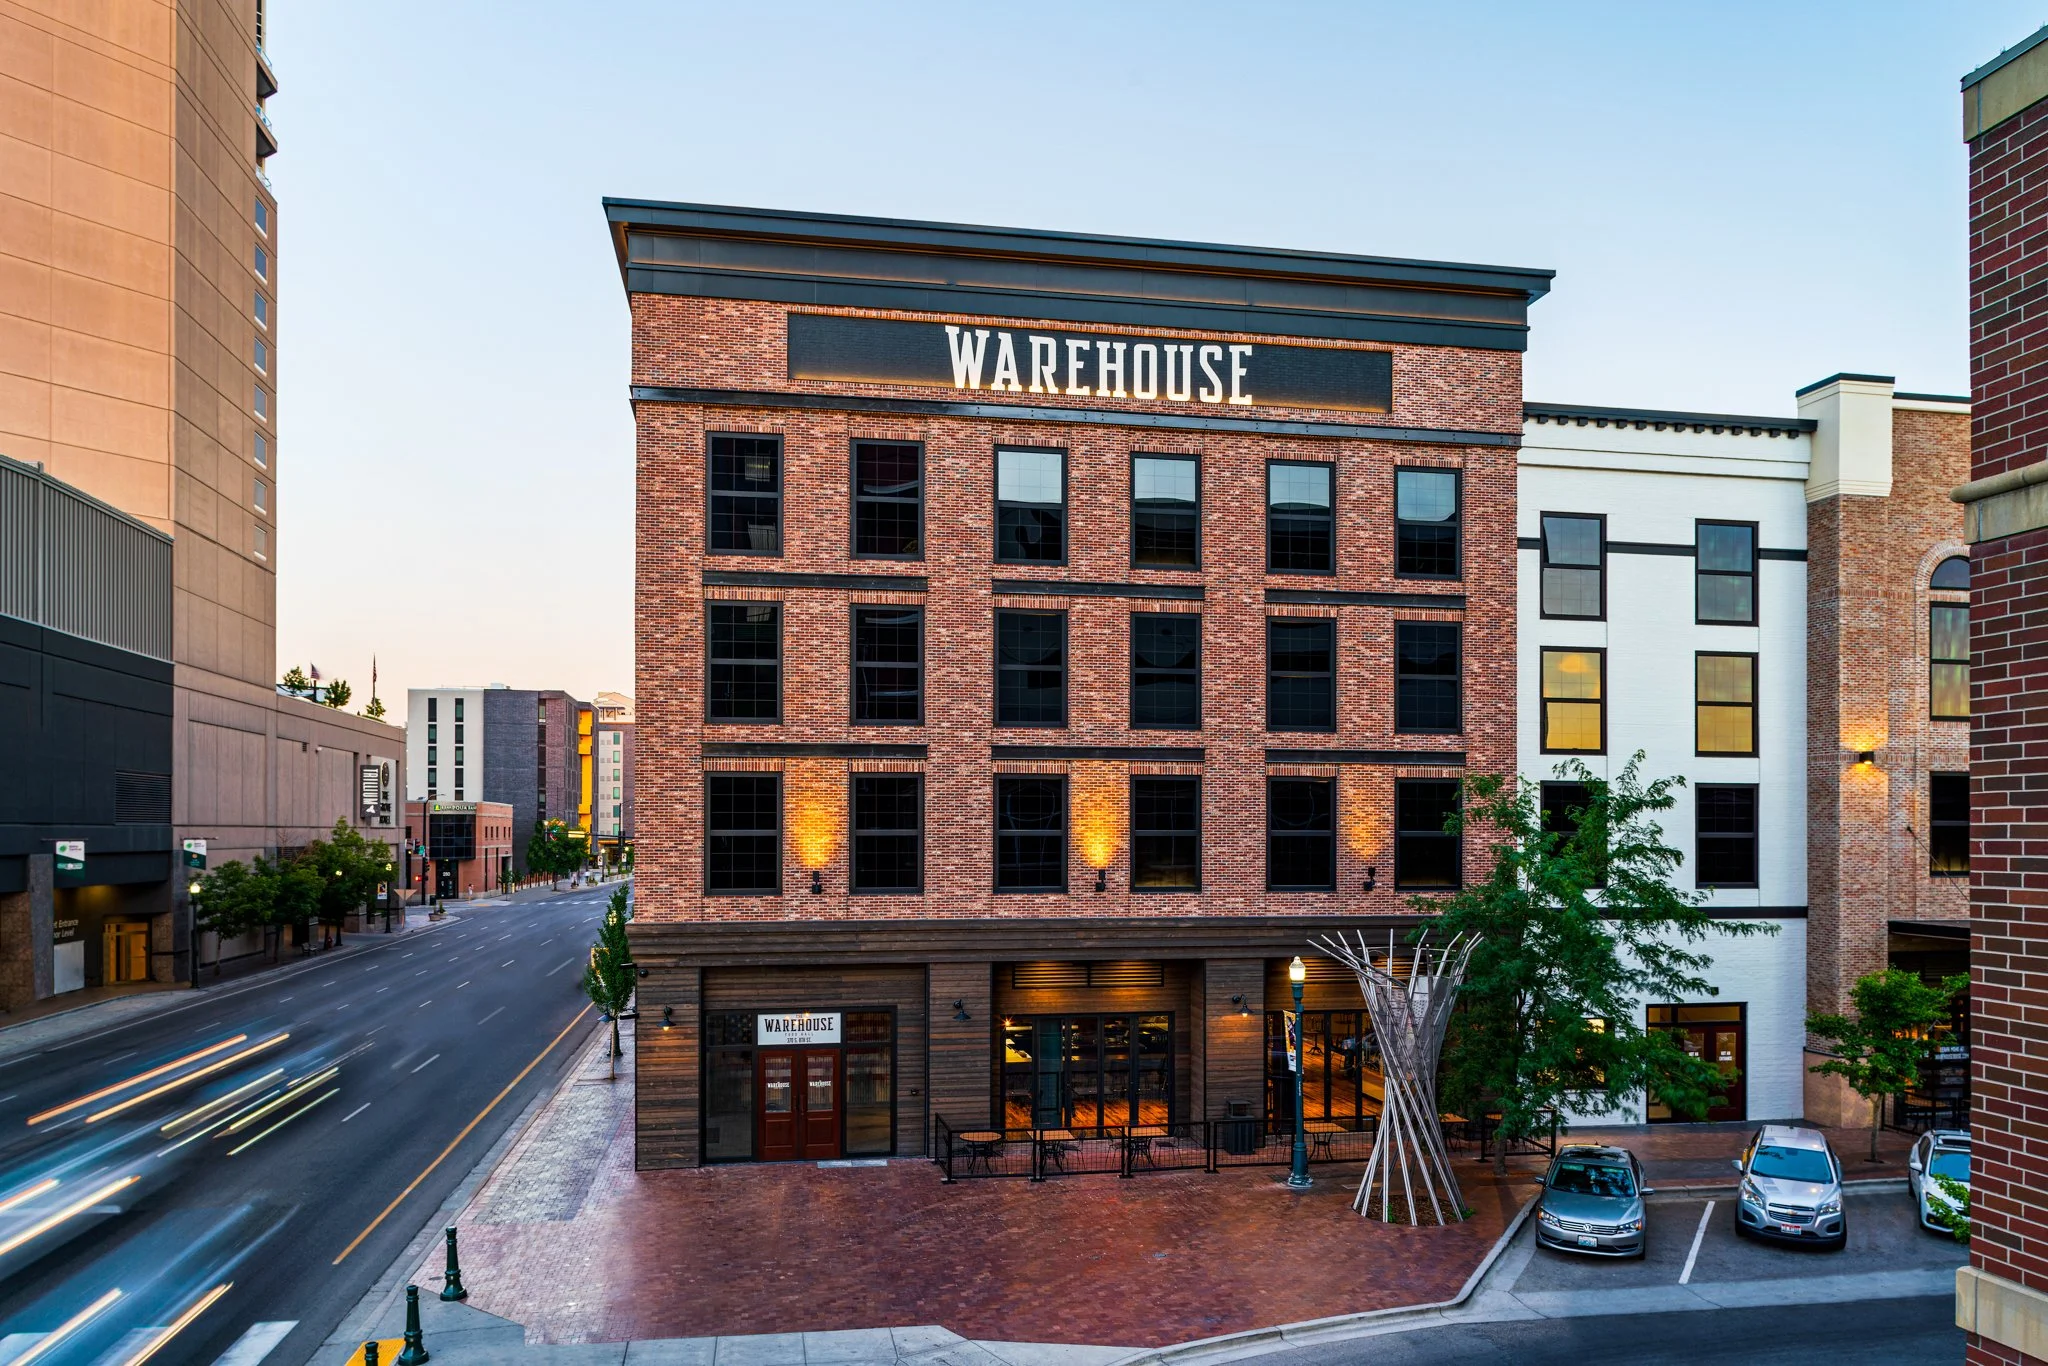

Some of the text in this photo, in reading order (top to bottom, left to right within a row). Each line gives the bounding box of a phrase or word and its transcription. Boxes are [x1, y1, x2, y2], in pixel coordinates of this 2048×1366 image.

[945, 325, 1253, 406] WAREHOUSE
[362, 768, 379, 805] TRILLIUM
[764, 1017, 834, 1033] WAREHOUSE
